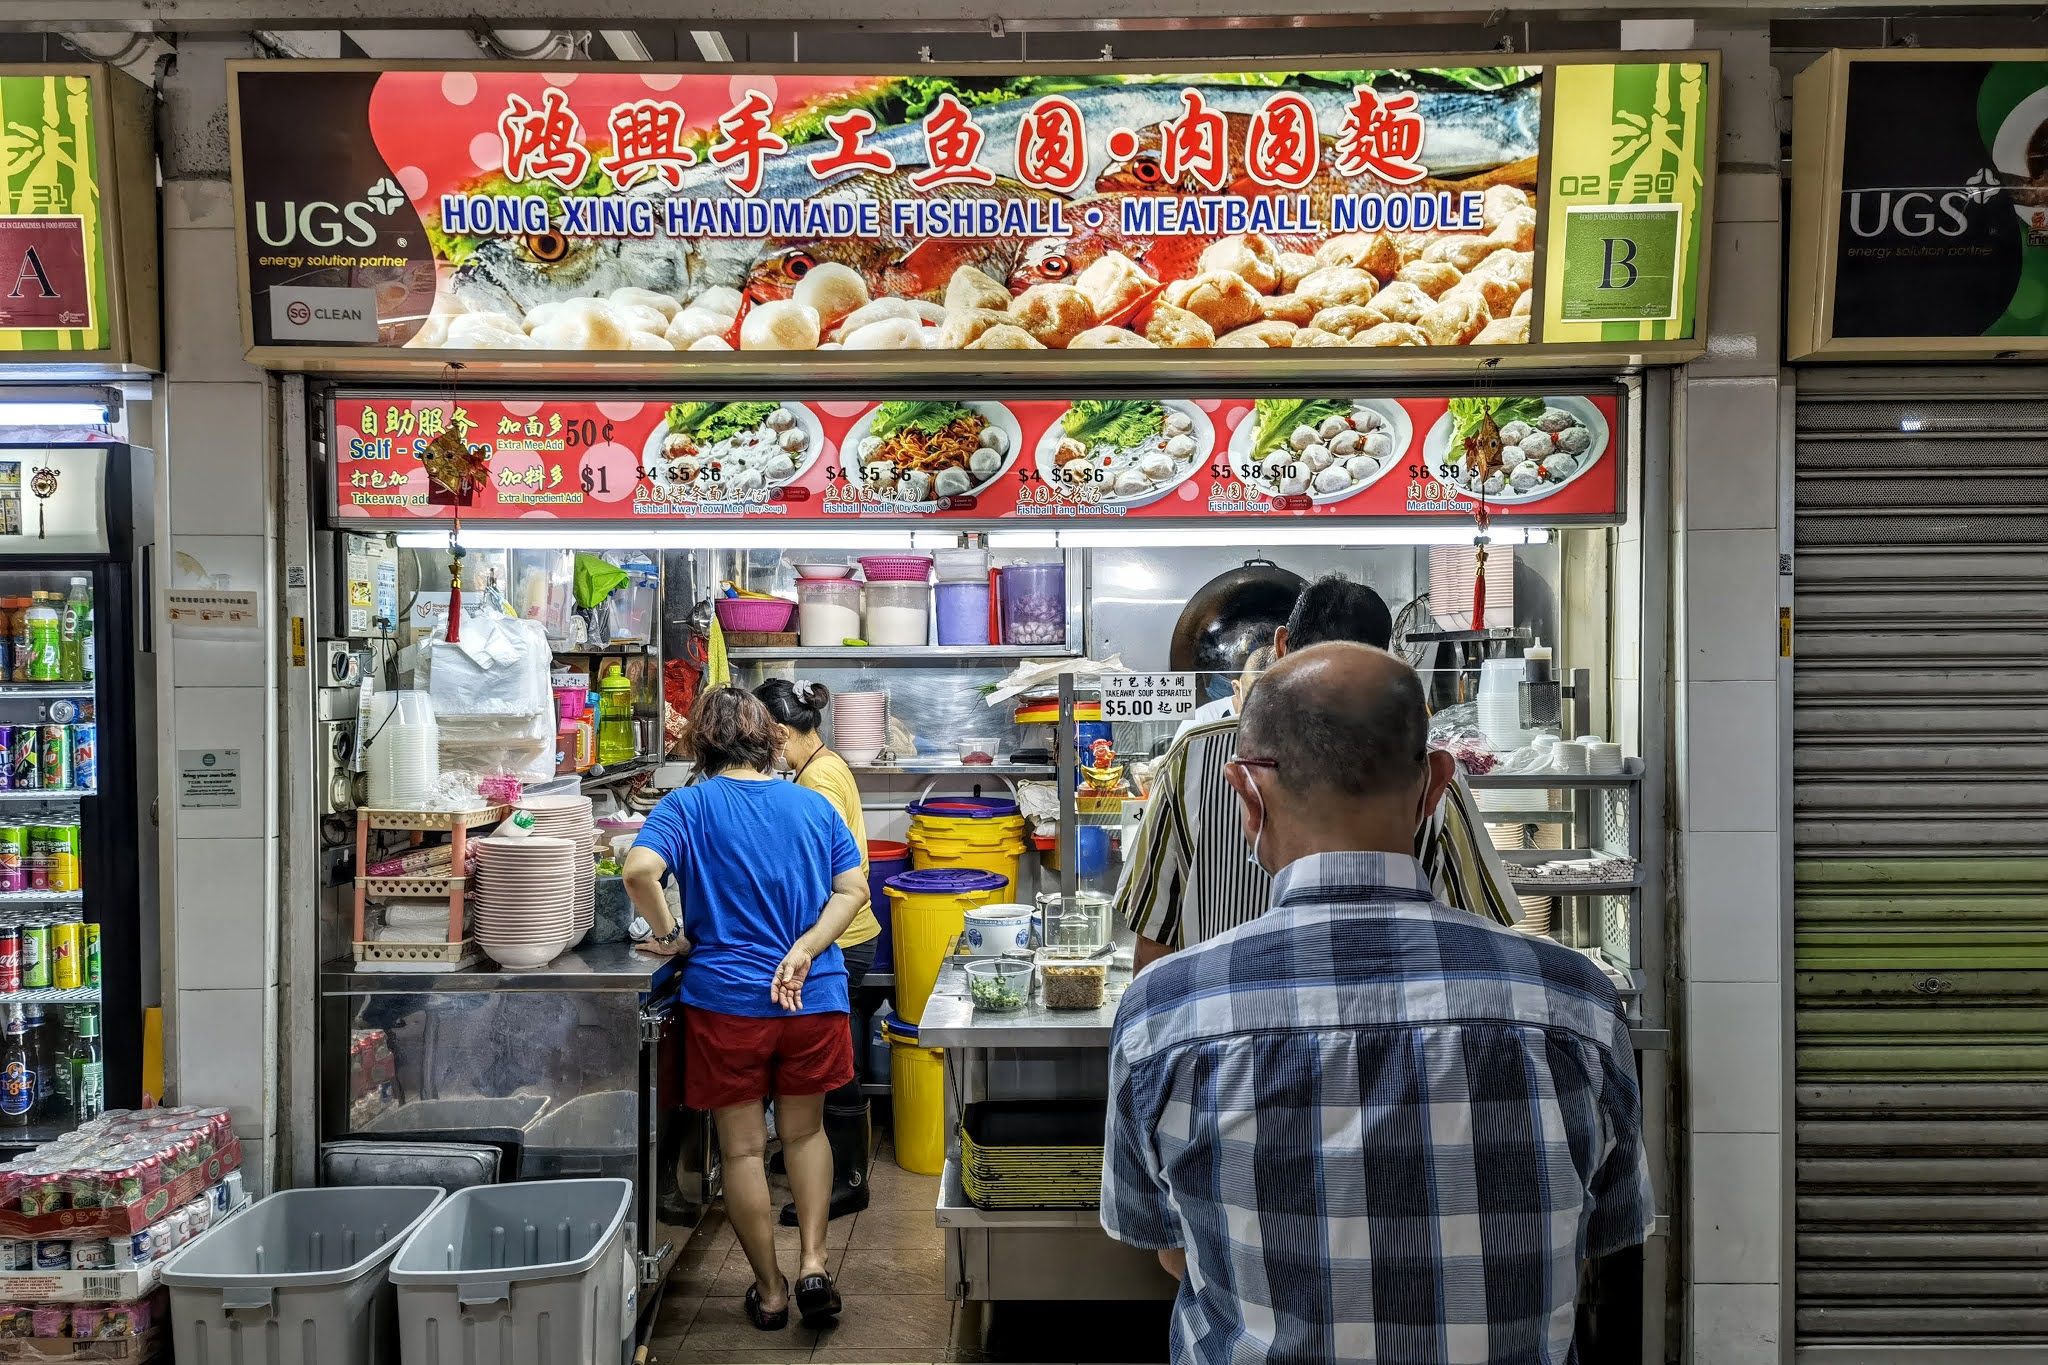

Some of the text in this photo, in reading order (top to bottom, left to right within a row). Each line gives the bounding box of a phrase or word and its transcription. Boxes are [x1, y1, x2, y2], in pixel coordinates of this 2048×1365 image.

[442, 190, 1485, 238] HONG XING HANDMADE FISHBALL MEATBALL NOODLE
[1850, 192, 1968, 238] UGS
[255, 201, 377, 247] UGS
[259, 254, 408, 268] energy solution partner
[1596, 238, 1639, 290] B
[7, 244, 61, 298] A
[290, 308, 362, 320] SG CLEAN
[361, 405, 479, 438] 自助服务
[497, 412, 563, 438] 加面多
[350, 438, 392, 460] Self
[497, 440, 522, 450] Extra
[524, 440, 544, 450] Mee
[545, 440, 564, 450] Add
[350, 469, 409, 489] 打包加
[498, 464, 564, 491] 加料多
[636, 466, 721, 481] $4 $5 $6
[826, 466, 912, 481] $4 $5 $6
[1019, 468, 1104, 483] $4 $5 $6
[1211, 464, 1297, 479] $5 $8 $10
[1409, 464, 1430, 479] $6
[1439, 464, 1460, 479] $9
[581, 464, 611, 496] $1
[1016, 485, 1102, 504] 鱼圆冬粉汤
[1209, 482, 1261, 500] 鱼圆汤
[1407, 481, 1458, 499] 肉圆汤
[352, 492, 411, 506] Takeaway
[498, 493, 583, 505] Extra Ingredient Add
[1407, 501, 1473, 512] Meatball Soup
[634, 504, 669, 514] Fishball
[671, 504, 696, 515] Kway
[699, 504, 722, 514] Teow
[724, 504, 742, 514] Mee
[823, 503, 859, 513] Fishball
[861, 503, 892, 513] Noodle
[1017, 505, 1127, 517] Fishball Tang Hoon Soup
[1209, 501, 1270, 513] Fishball Soup
[1105, 689, 1192, 697] TAKEAWAY SOUP SEPARATELY
[1105, 700, 1192, 717] $5.00 起 UP
